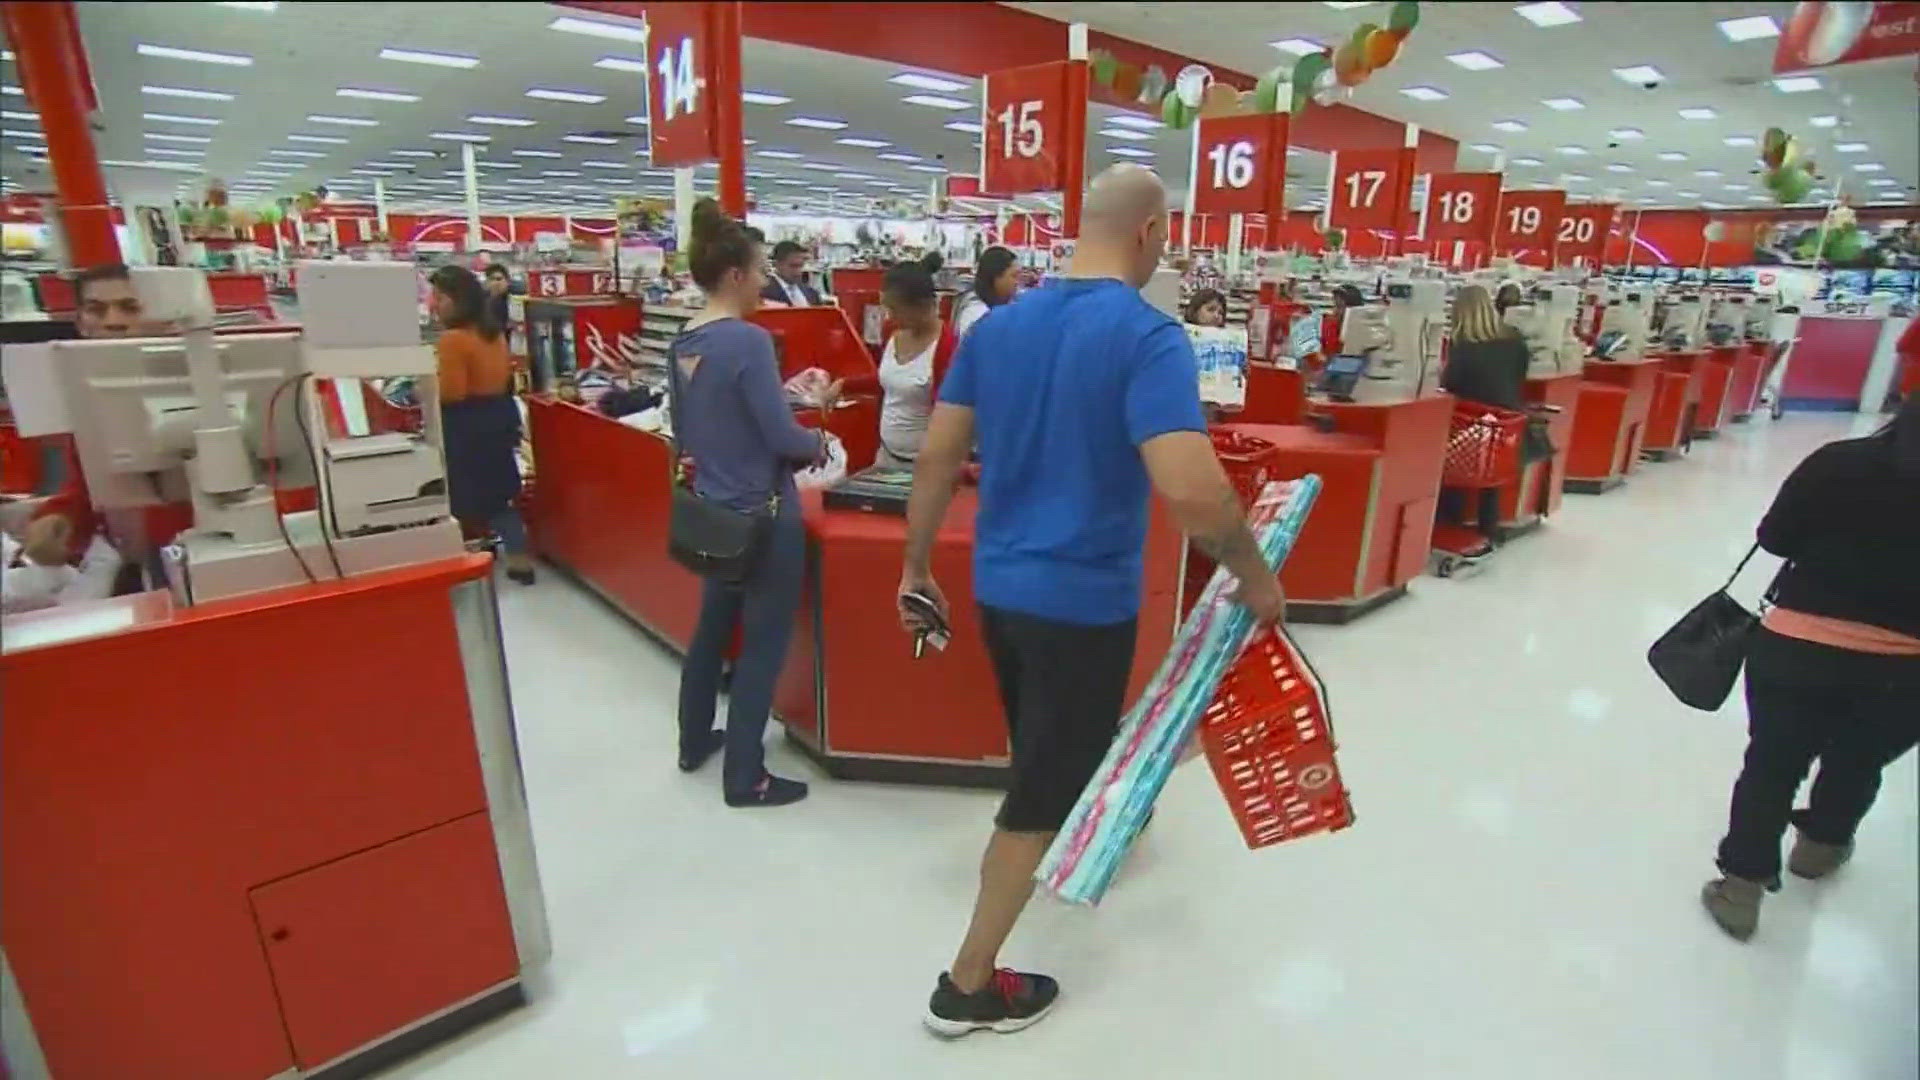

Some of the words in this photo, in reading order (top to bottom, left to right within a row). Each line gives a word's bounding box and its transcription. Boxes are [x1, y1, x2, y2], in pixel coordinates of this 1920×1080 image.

[658, 37, 706, 121] 14
[998, 100, 1044, 159] 15
[1208, 141, 1255, 189] 16
[1345, 171, 1386, 208] 17
[1439, 191, 1474, 223] 18
[1507, 206, 1541, 234] 19
[1557, 217, 1594, 243] 20
